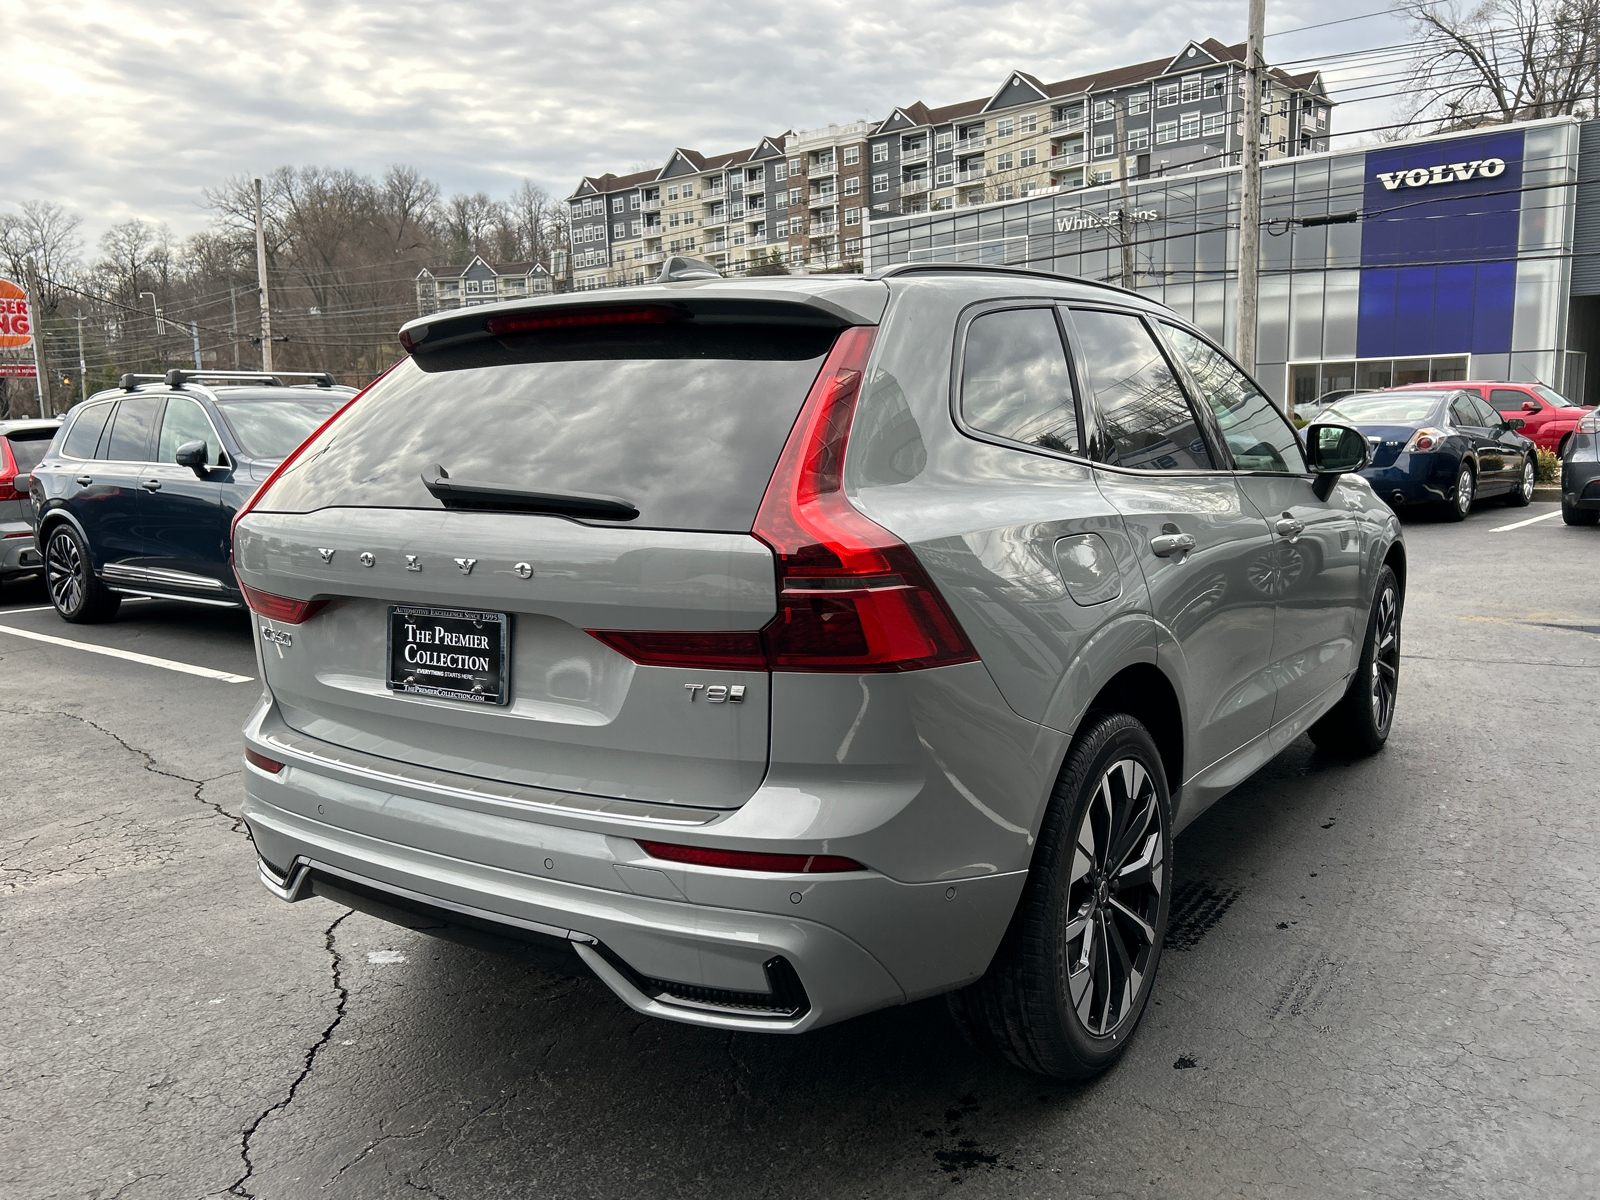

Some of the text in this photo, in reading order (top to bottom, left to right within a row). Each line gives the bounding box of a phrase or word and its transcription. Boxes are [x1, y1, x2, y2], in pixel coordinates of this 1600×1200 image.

[1376, 158, 1506, 190] VOLVO
[318, 547, 534, 580] VOLVO
[482, 613, 498, 621] 1995
[404, 623, 490, 650] THE PREMIER
[404, 643, 490, 672] COLLECTION
[416, 668, 444, 677] EVERYTHING
[444, 671, 461, 679] STARTS
[684, 683, 728, 703] T8
